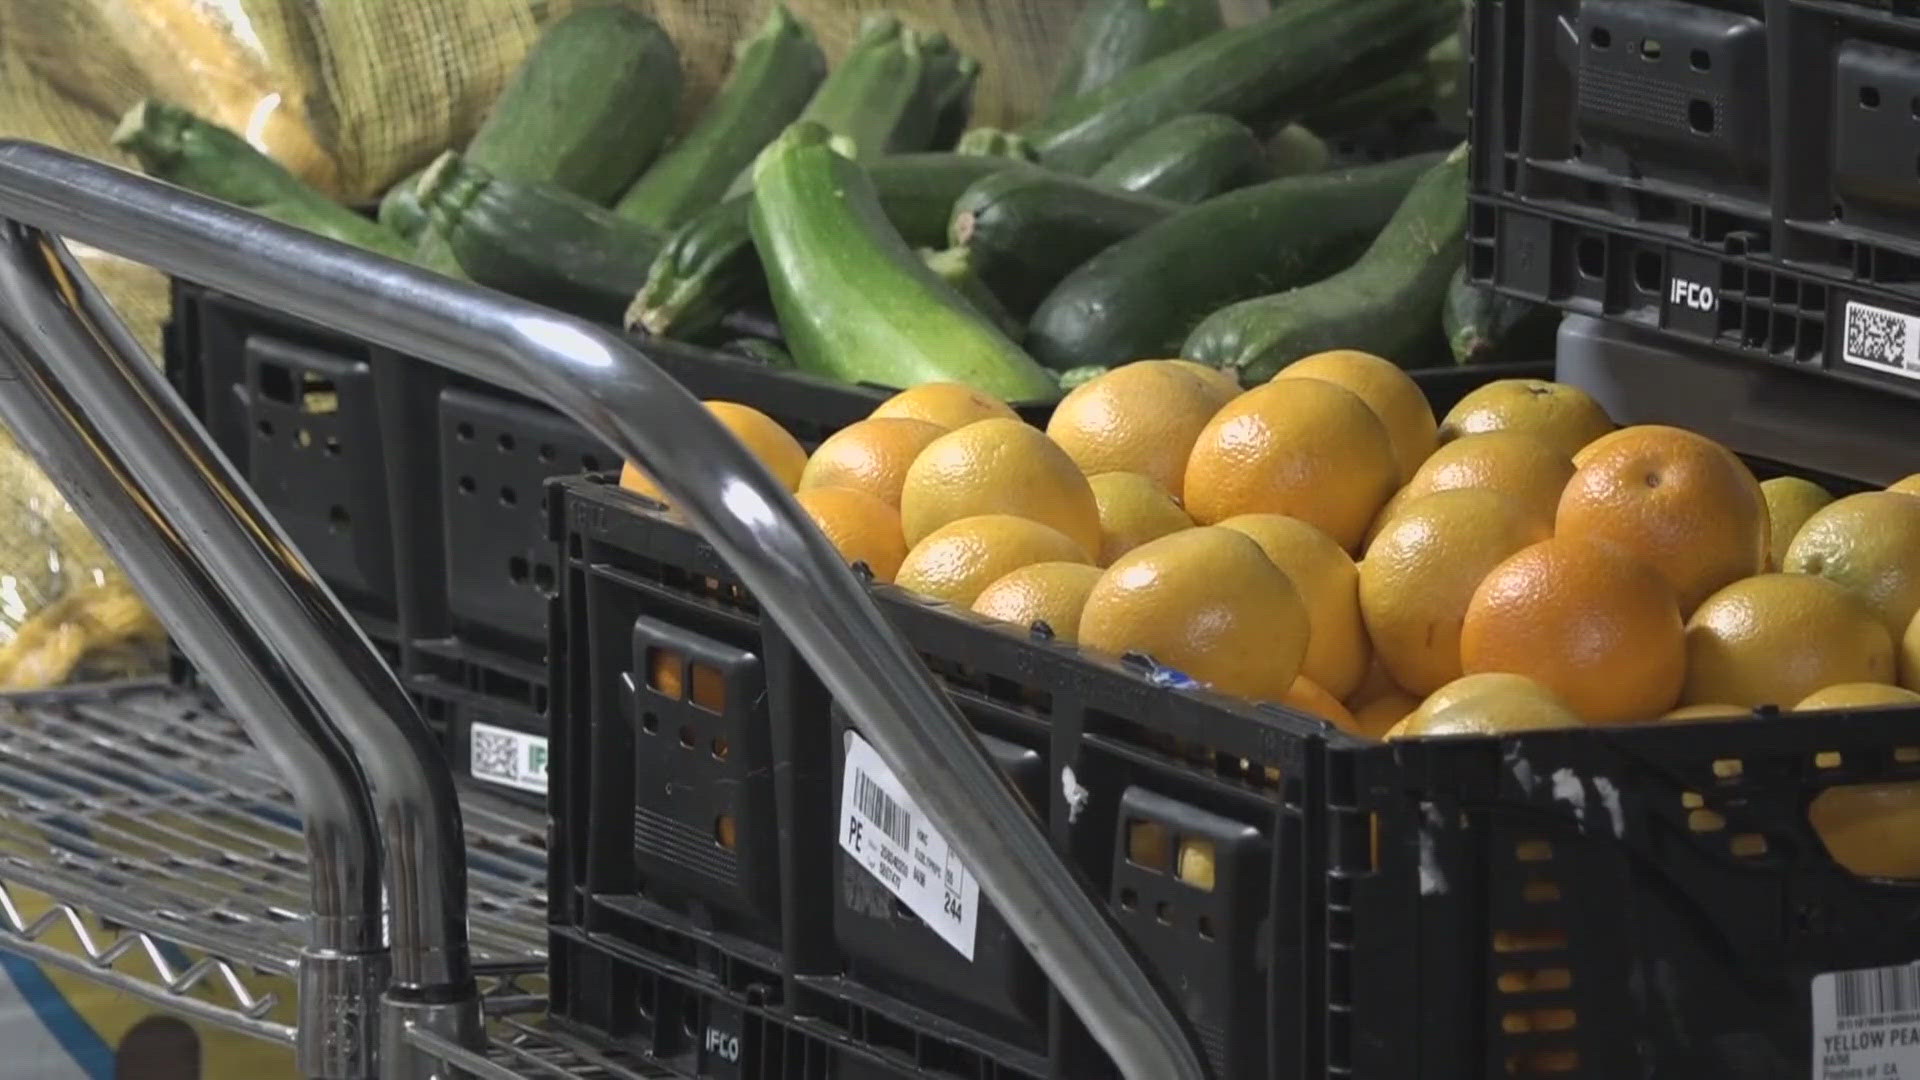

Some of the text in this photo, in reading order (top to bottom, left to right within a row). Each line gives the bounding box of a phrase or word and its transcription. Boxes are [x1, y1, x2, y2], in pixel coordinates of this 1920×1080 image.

[1671, 278, 1713, 311] IFCO
[848, 815, 863, 853] PE
[944, 891, 962, 922] 244
[705, 1026, 739, 1062] IFCO
[1824, 1031, 1884, 1052] YELLOW
